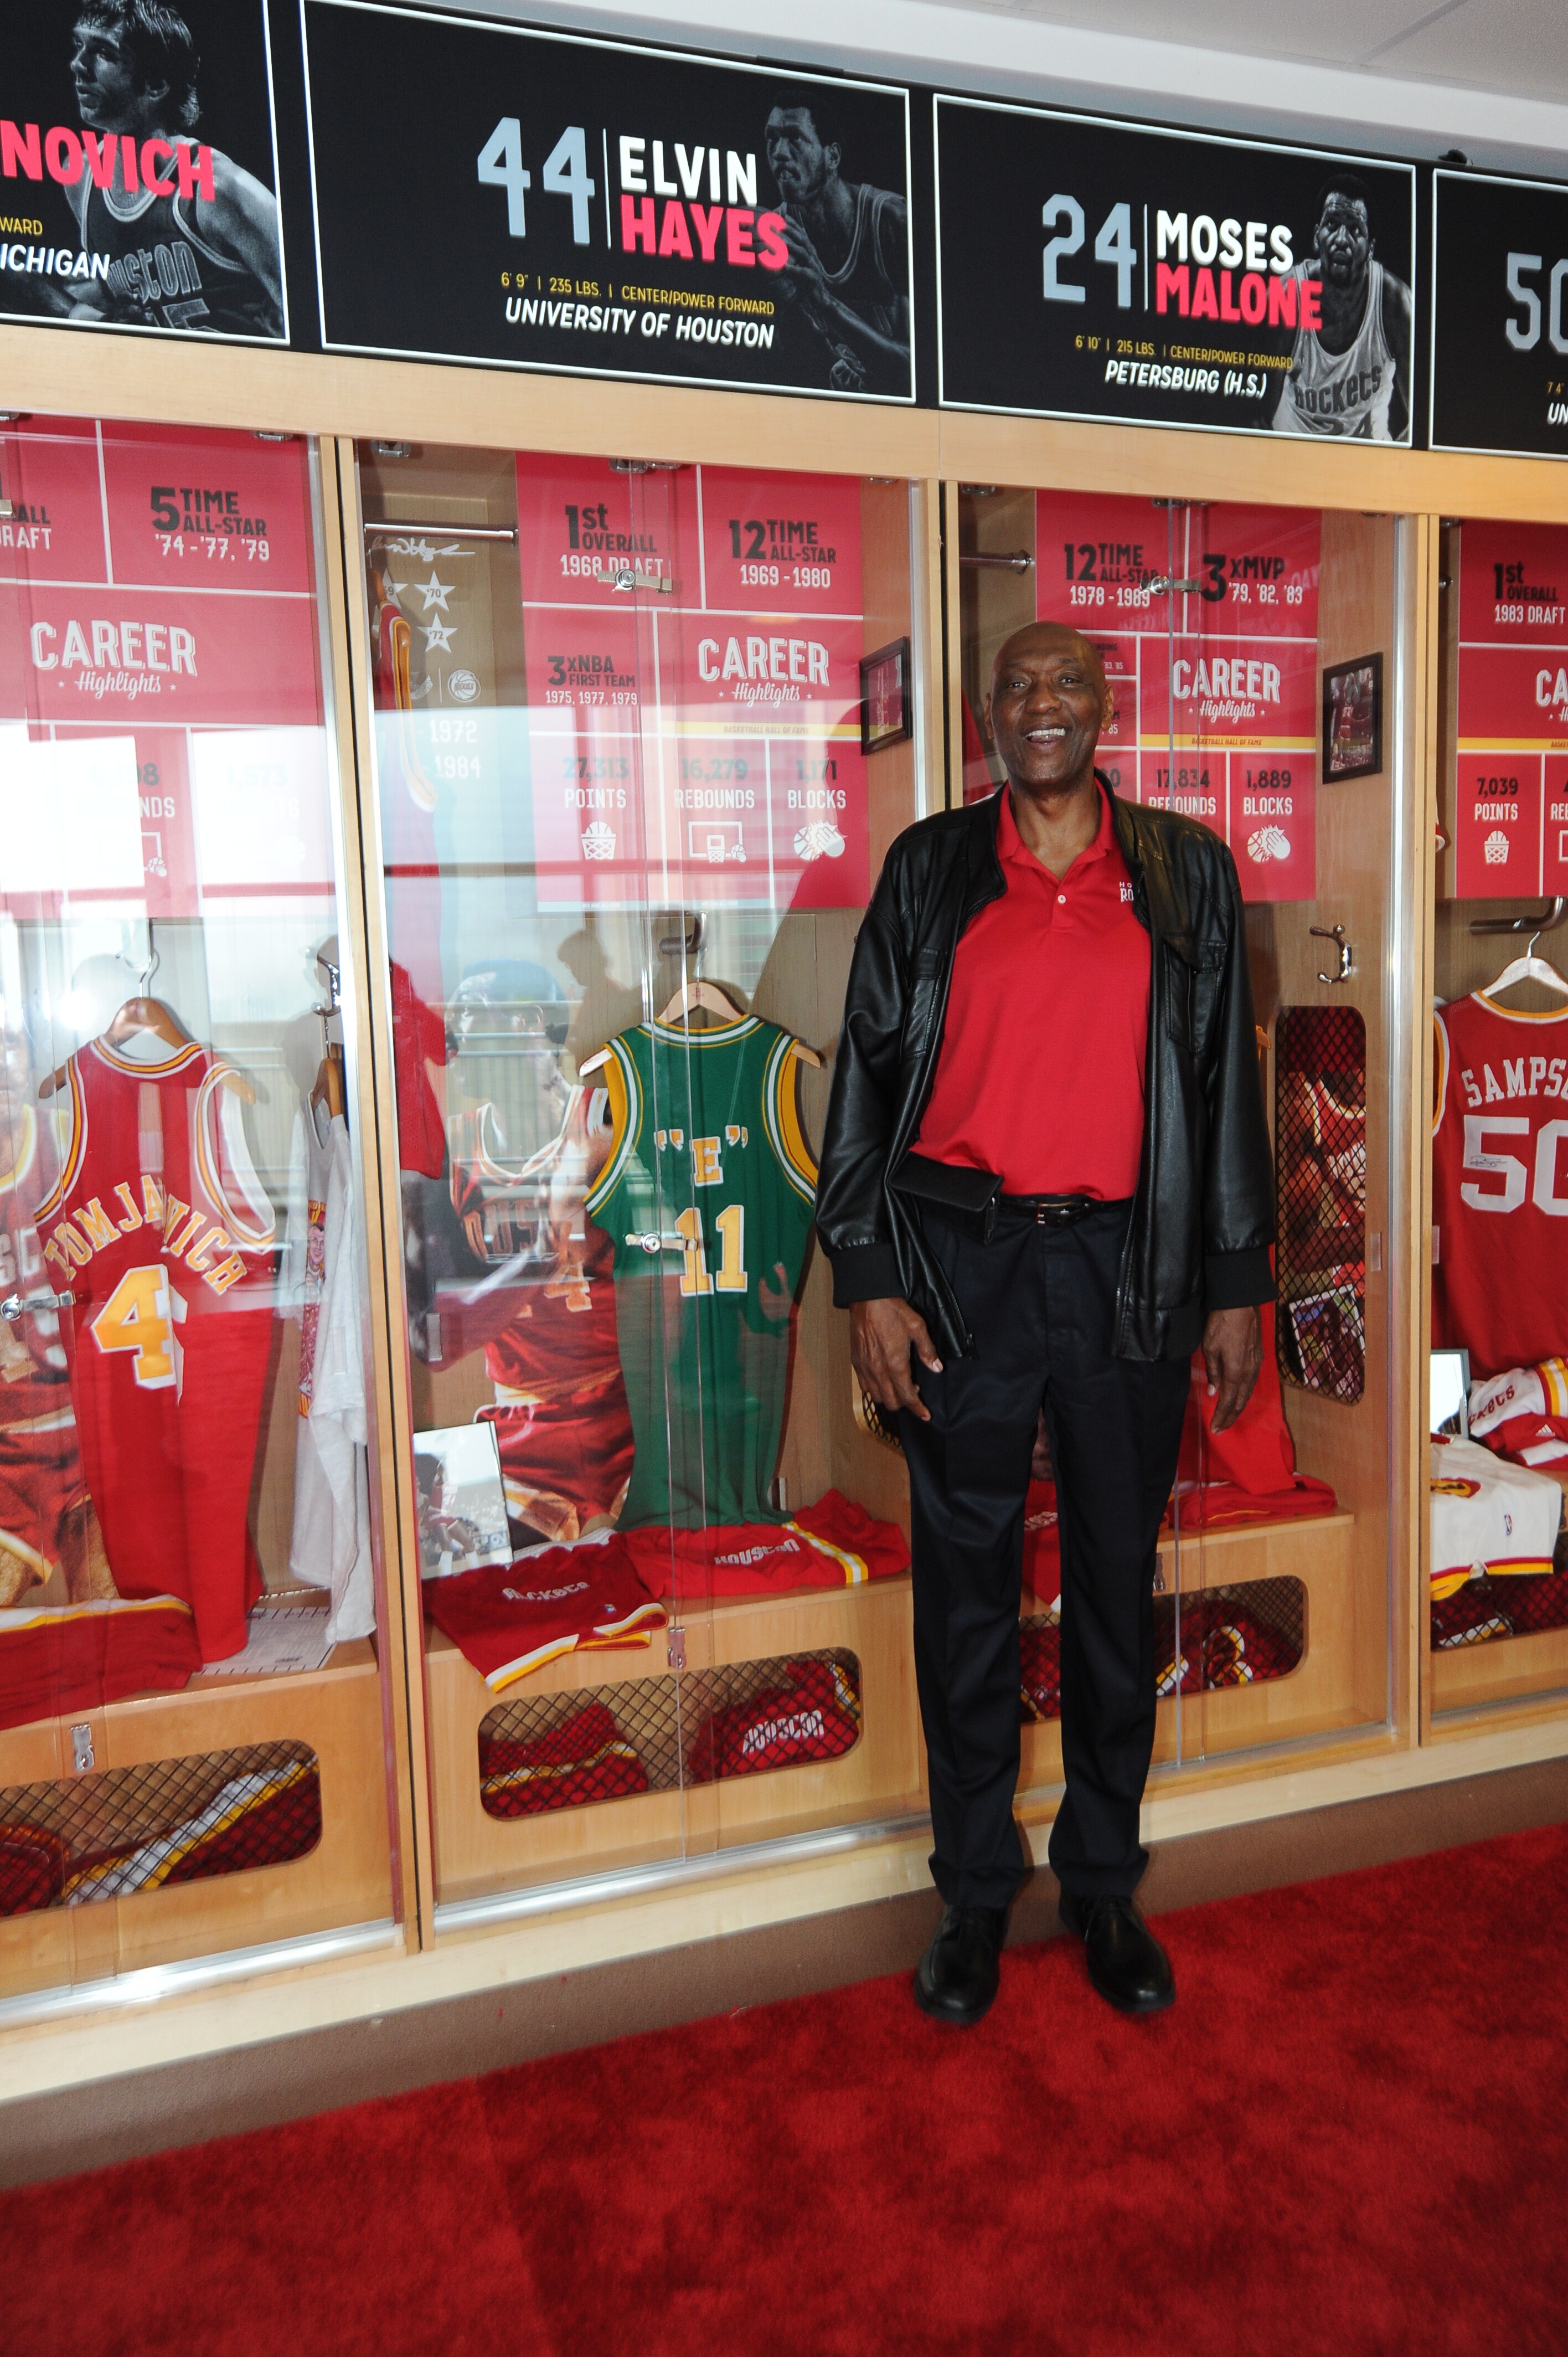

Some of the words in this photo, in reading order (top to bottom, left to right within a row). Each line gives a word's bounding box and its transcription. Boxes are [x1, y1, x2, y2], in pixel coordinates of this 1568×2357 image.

[0, 120, 215, 202] NOVICH
[477, 117, 595, 246] 44
[620, 135, 757, 207] ELVIN
[620, 194, 789, 270] HAYES
[1042, 194, 1137, 310] 24
[1156, 210, 1294, 274] MOSES
[550, 277, 572, 294] 235
[576, 280, 601, 297] LBS.
[621, 285, 715, 309] CENTER/POWER
[719, 296, 774, 315] FORWARD
[1156, 263, 1323, 331] MALONE
[506, 297, 636, 334] UNIVERSITY
[641, 312, 670, 337] OF
[675, 315, 775, 348] HOUSTON
[1117, 339, 1132, 354] 215
[1170, 345, 1245, 365] CENTER/POWER
[1248, 354, 1294, 369] FORWARD
[1105, 359, 1220, 394] PETERSBURG
[1224, 369, 1267, 399] (H.S.)
[151, 486, 180, 532] 5
[179, 488, 239, 514] TIME
[0, 525, 52, 549] RAFT
[183, 514, 266, 536] ALL-STAR
[565, 503, 608, 549] 1st
[582, 532, 657, 553] OVERALL
[729, 519, 767, 560] 12
[767, 519, 818, 545] TIME
[560, 554, 602, 576] 1968
[771, 544, 837, 564] ALL-STAR
[1065, 543, 1096, 581] 12
[1098, 543, 1143, 566] TIME
[740, 564, 778, 586] 1969
[793, 567, 831, 589] 1980
[1201, 554, 1227, 603] 3
[1494, 560, 1524, 600] 1st
[1070, 585, 1105, 606] 1978
[1116, 587, 1150, 608] 1989
[1508, 585, 1558, 602] OVERALL
[1495, 604, 1524, 622] 1983
[1528, 605, 1566, 624] DRAFT
[31, 620, 198, 676] CAREER
[548, 655, 566, 686] 3
[698, 636, 829, 687] CAREER
[75, 671, 162, 699] Highlights
[569, 673, 601, 686] FIRST
[605, 674, 636, 687] TEAM
[1173, 657, 1281, 703] CAREER
[611, 692, 637, 705] 1979
[733, 682, 801, 708] Highlights
[1200, 699, 1256, 724] Highlights
[429, 719, 477, 743] 1972
[1192, 737, 1224, 745] BASKETBALL
[435, 755, 481, 778] 1984
[563, 756, 629, 781] 27,313
[680, 758, 749, 783] 16,279
[1246, 769, 1292, 791] 1,889
[1477, 777, 1519, 797] 7,039
[140, 796, 176, 818] NDS
[564, 788, 627, 809] POINTS
[675, 789, 755, 809] REBOUNDS
[788, 789, 847, 809] BLOCKS
[1243, 796, 1293, 815] BLOCKS
[1474, 803, 1518, 820] POINTS
[674, 1205, 748, 1297] 11
